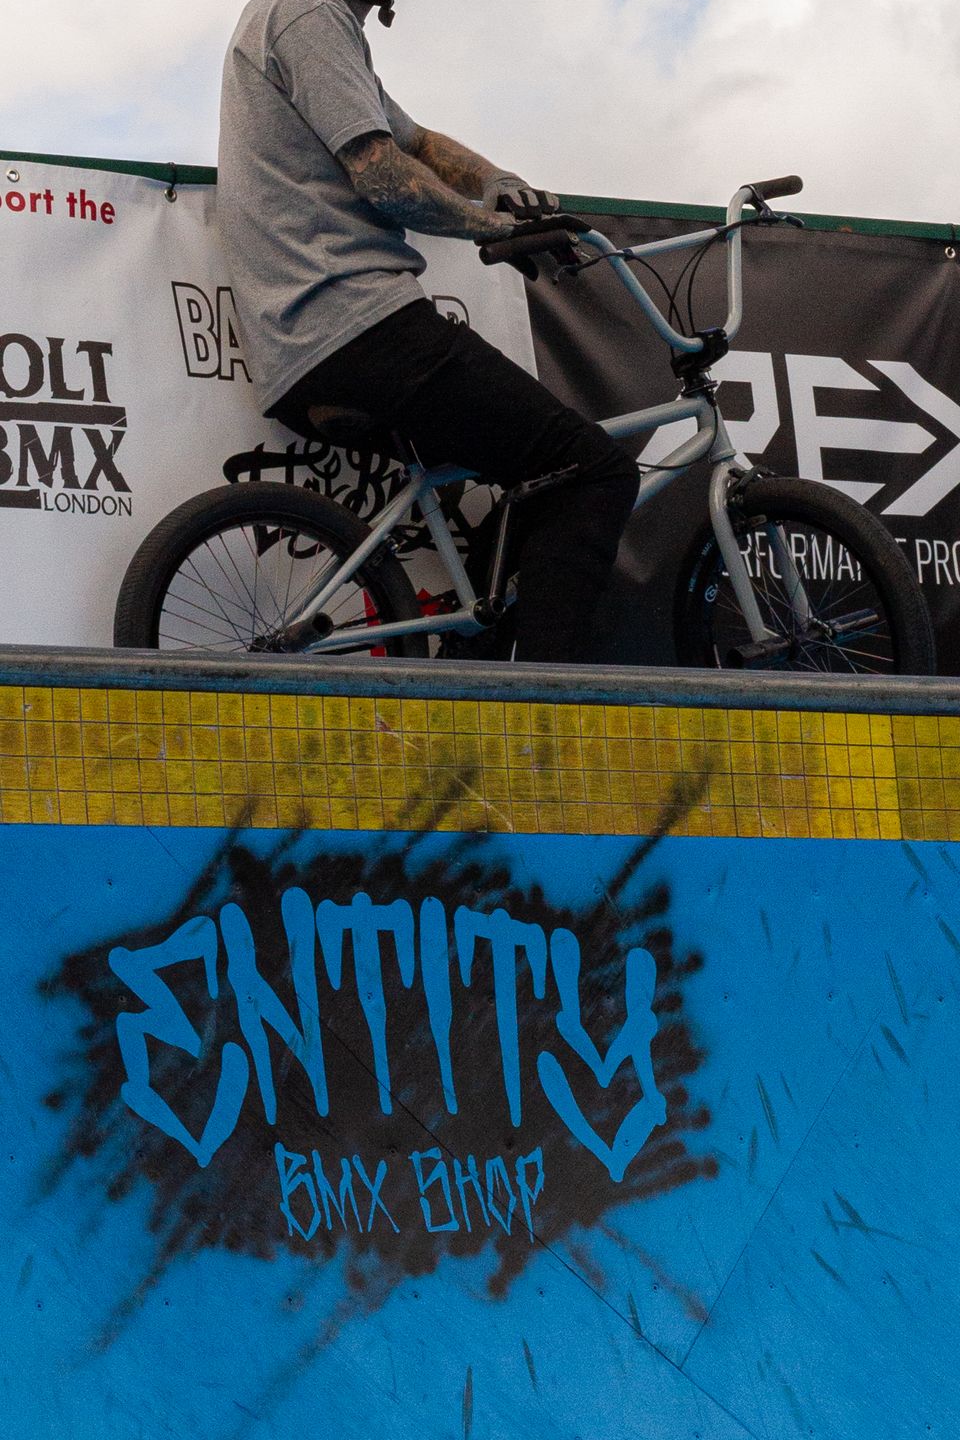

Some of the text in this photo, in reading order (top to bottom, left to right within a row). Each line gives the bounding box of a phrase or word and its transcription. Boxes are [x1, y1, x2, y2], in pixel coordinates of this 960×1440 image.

[0, 189, 116, 224] ort the
[43, 492, 132, 516] LONDON
[108, 887, 667, 1182] ENTITY
[274, 1142, 545, 1243] BMX SHOP
